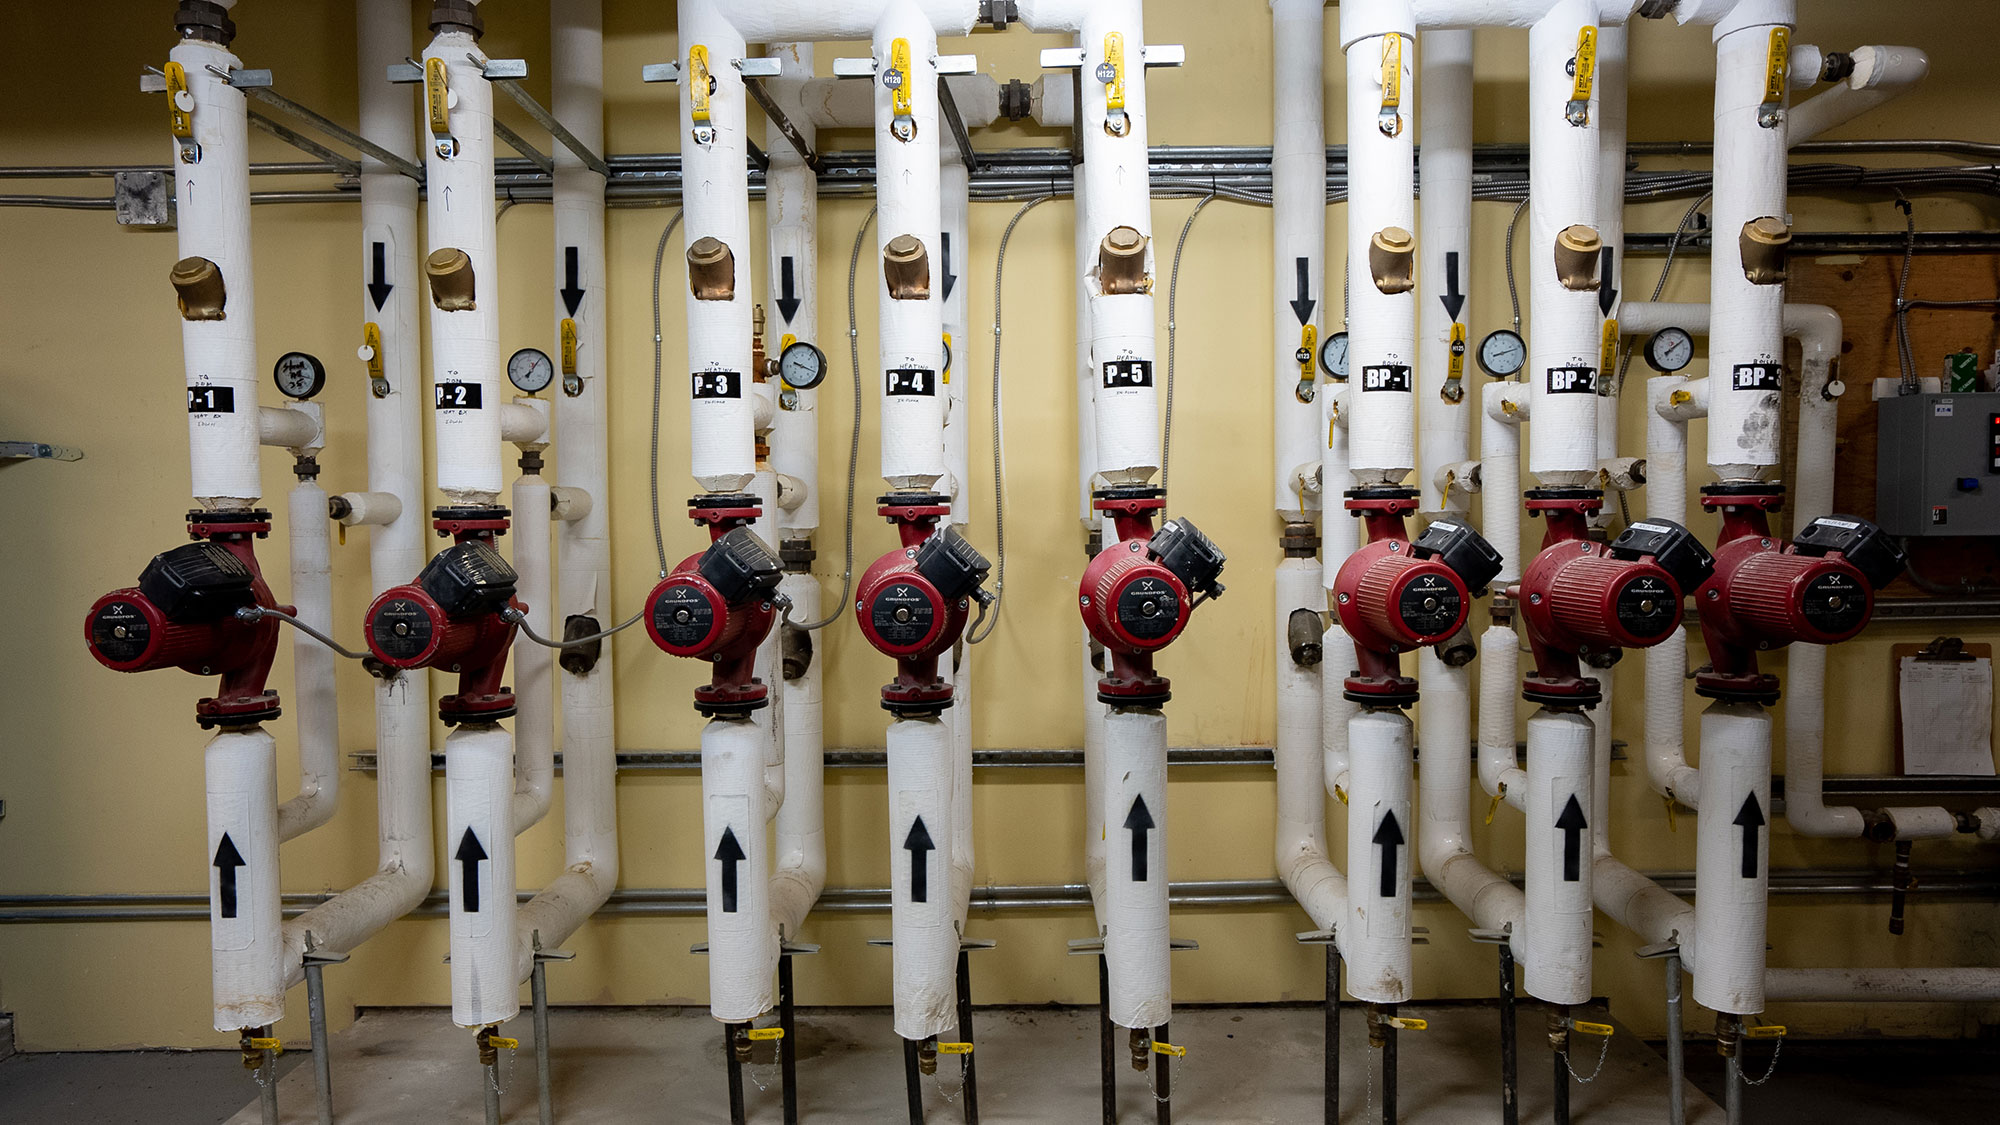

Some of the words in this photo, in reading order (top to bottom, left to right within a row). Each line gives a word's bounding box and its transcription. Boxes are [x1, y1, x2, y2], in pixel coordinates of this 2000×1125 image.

[884, 76, 901, 84] H120
[1097, 70, 1115, 78] H122
[889, 372, 924, 392] P-4
[1107, 363, 1143, 384] P-5
[1367, 368, 1409, 388] BP-1
[1552, 370, 1596, 390] BP-2
[694, 375, 728, 395] P-3
[436, 386, 467, 405] P-2
